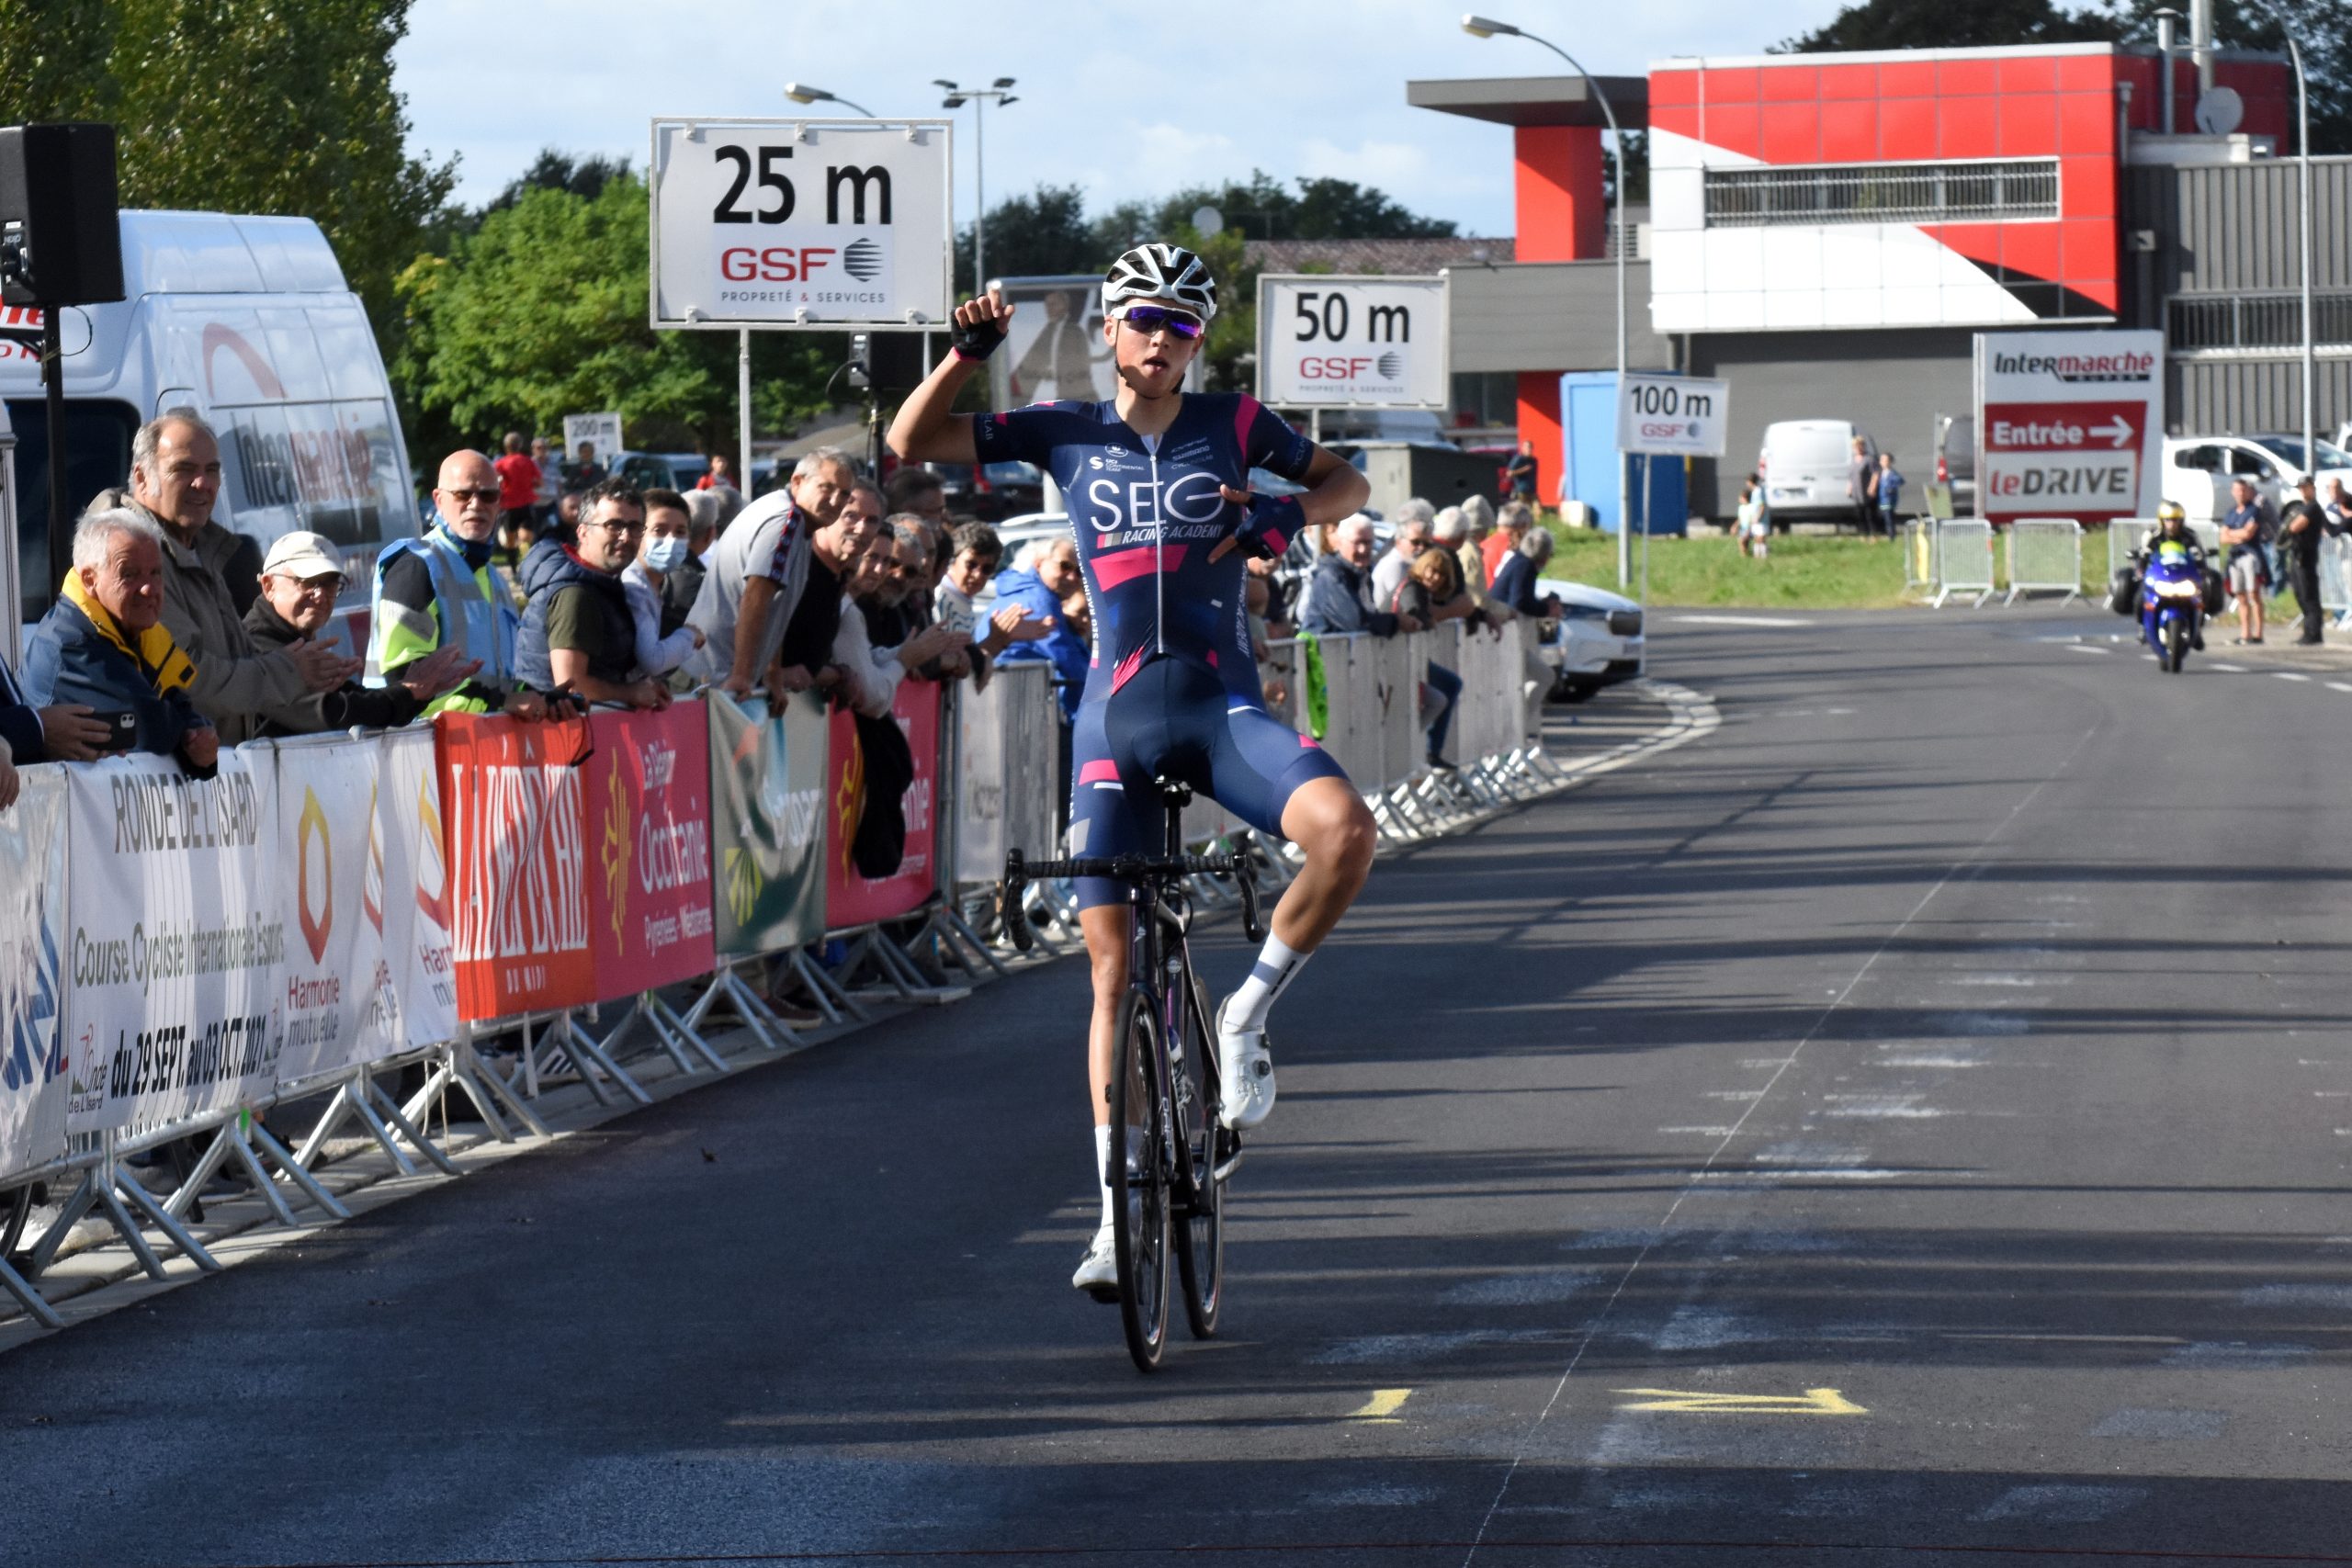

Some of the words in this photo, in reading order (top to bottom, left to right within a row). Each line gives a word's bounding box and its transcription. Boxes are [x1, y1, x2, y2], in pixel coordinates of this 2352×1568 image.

[714, 145, 796, 225] 25
[826, 164, 891, 225] m
[721, 247, 836, 282] GSF
[721, 289, 792, 302] PROPRETÉ
[800, 292, 809, 302] &
[817, 292, 886, 303] SERVICES
[1295, 292, 1349, 343] 50
[1368, 305, 1409, 344] m
[1300, 356, 1373, 379] GSF
[1631, 385, 1678, 415] 100
[1685, 394, 1711, 417] m
[1641, 423, 1684, 437] GSF
[1993, 421, 2084, 446] Entrée
[1090, 472, 1225, 531] SEG
[1123, 526, 1168, 544] RACING
[1170, 524, 1225, 537] ACADEMY
[110, 773, 176, 853] RONDE
[173, 773, 202, 848] DE
[200, 772, 256, 848] L'ISARD
[639, 795, 708, 894] Occitanie
[74, 926, 129, 988] Course
[133, 921, 184, 998] Cycliste
[187, 913, 255, 976] Internationale
[288, 971, 339, 1010] Harmonie
[288, 1009, 338, 1047] mutuelle
[111, 1030, 132, 1100] du
[131, 1032, 152, 1096] 29
[151, 1025, 186, 1093] SEPT.
[187, 1038, 203, 1088] au
[202, 1022, 219, 1085] 03
[219, 1018, 241, 1081] OCT.
[240, 1014, 266, 1077] 2021
